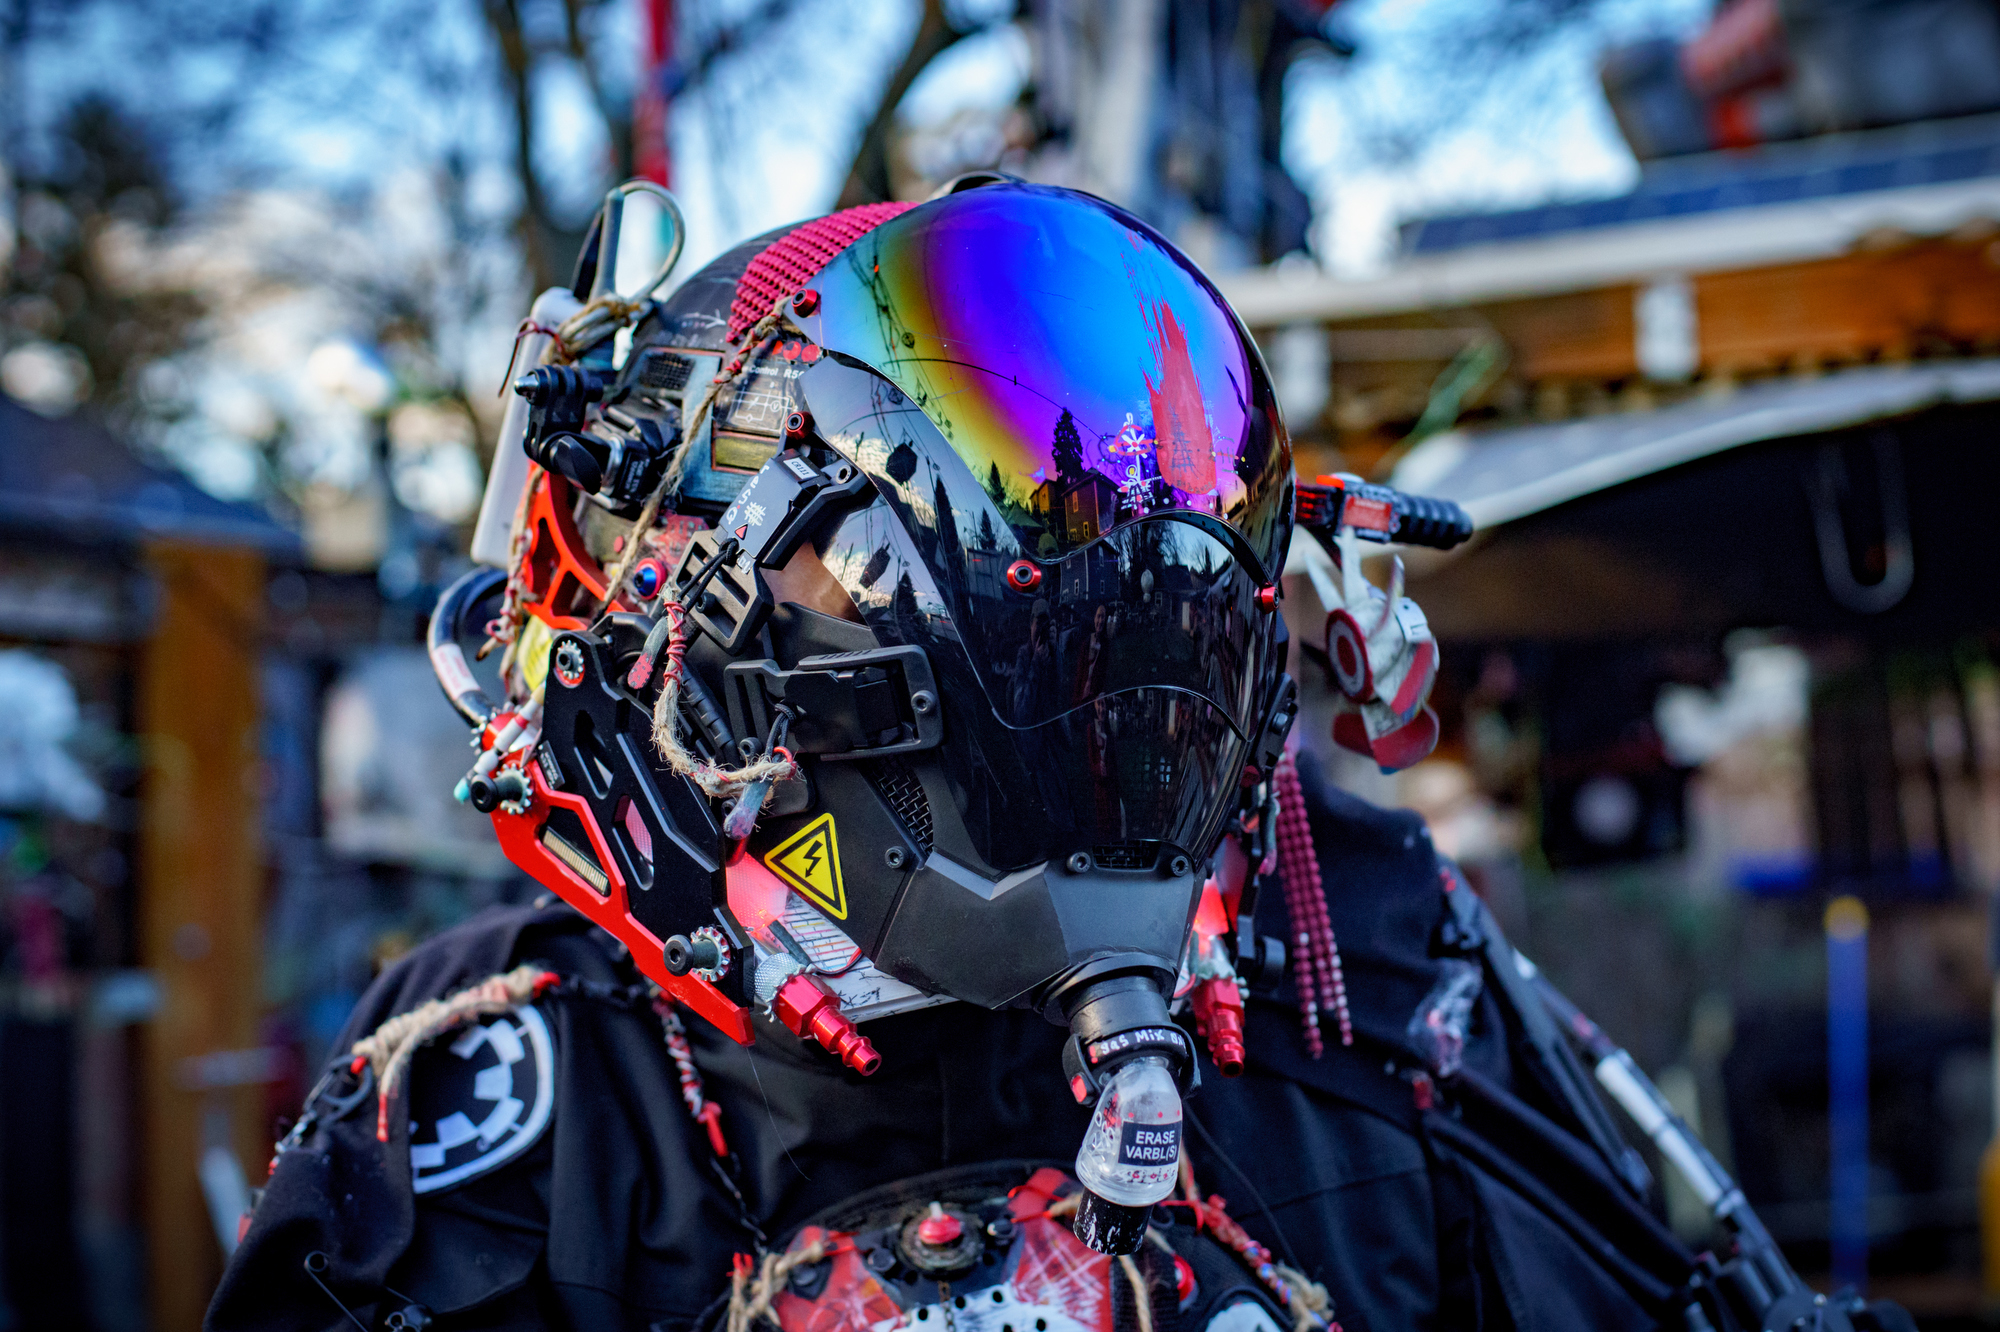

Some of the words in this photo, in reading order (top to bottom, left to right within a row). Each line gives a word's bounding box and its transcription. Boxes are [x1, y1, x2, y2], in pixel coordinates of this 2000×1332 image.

[749, 366, 779, 376] Control
[1135, 1029, 1164, 1043] Mix
[1136, 1130, 1175, 1144] ERASE
[1126, 1145, 1177, 1161] VARBL(S)
